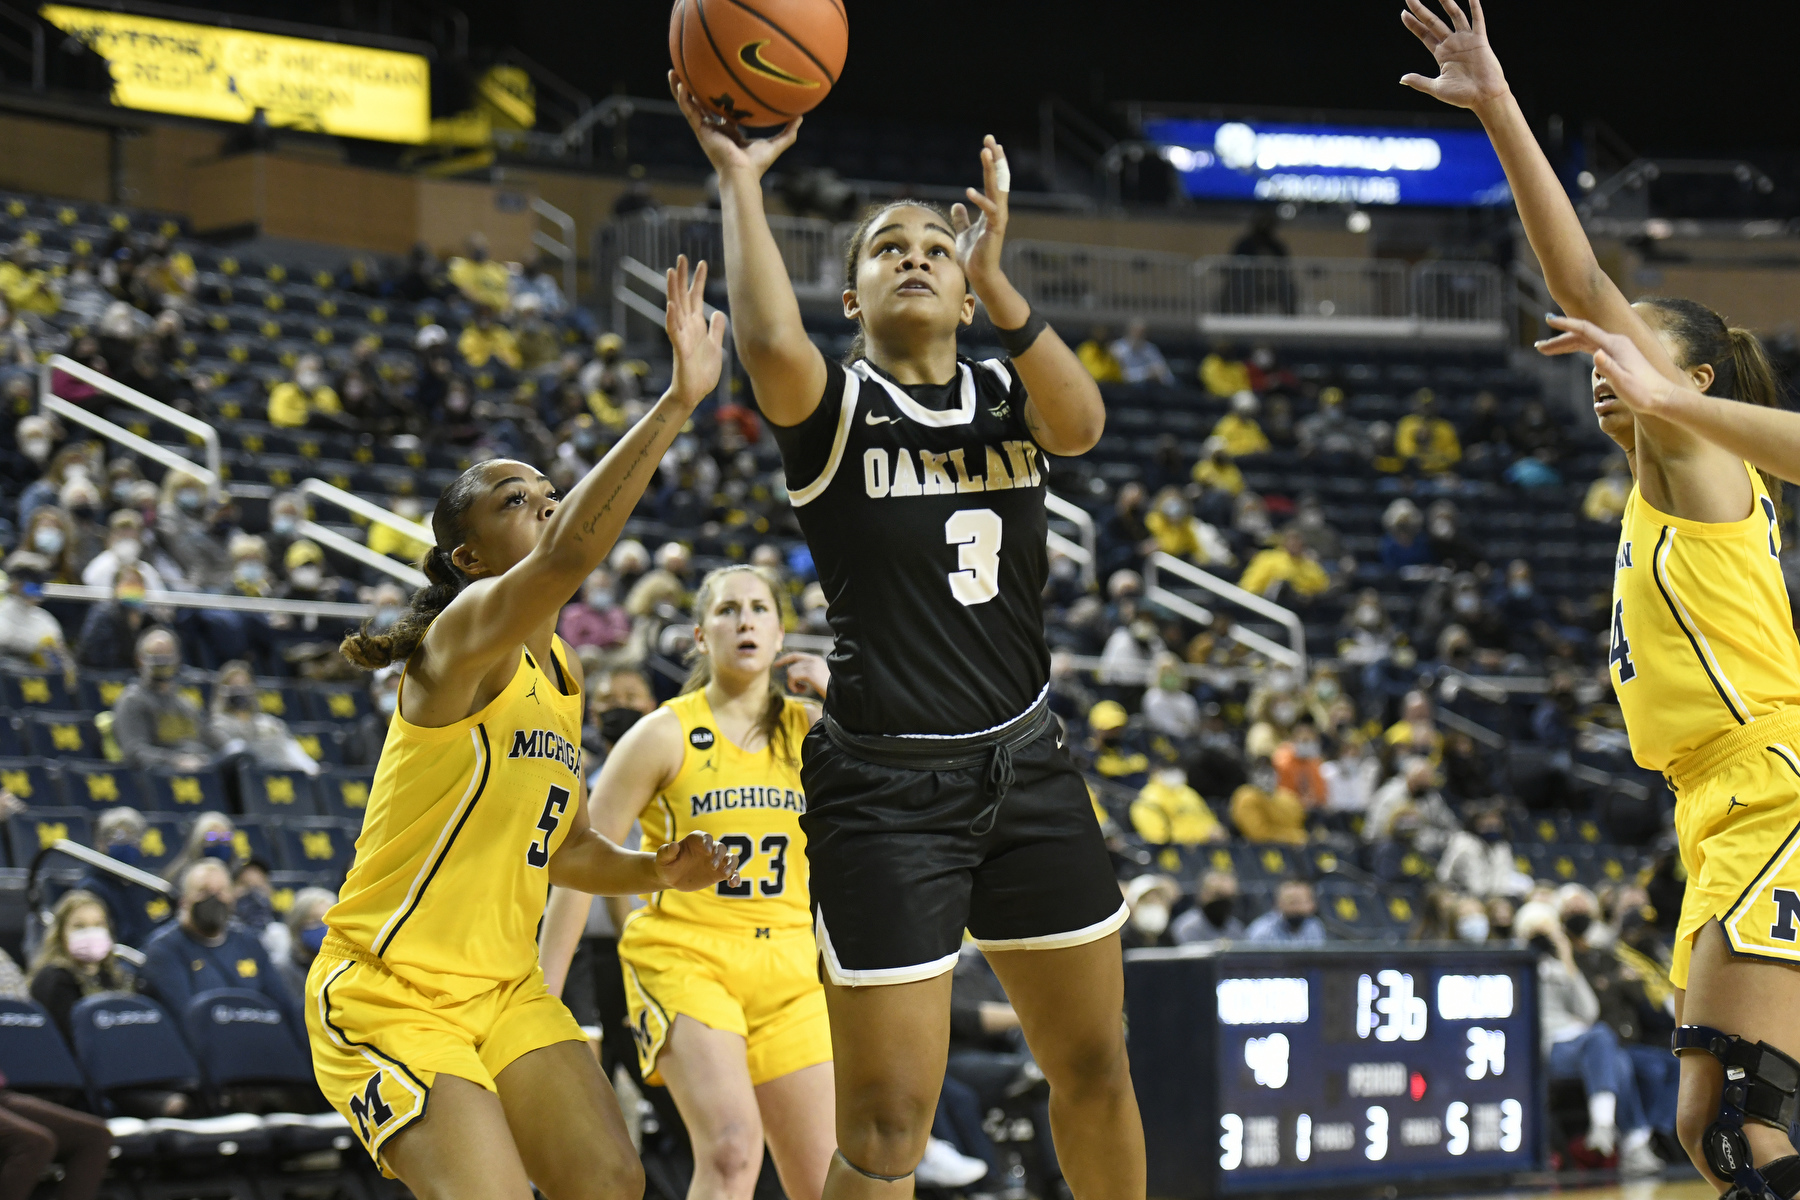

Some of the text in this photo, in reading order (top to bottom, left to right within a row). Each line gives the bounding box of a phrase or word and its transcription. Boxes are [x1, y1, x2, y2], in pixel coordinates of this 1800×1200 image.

[945, 508, 1002, 606] 3
[526, 782, 571, 869] 5
[716, 833, 790, 899] 23
[348, 1068, 396, 1148] M
[1365, 1105, 1389, 1161] 3
[1445, 1101, 1470, 1156] 5
[1500, 1098, 1523, 1153] 3
[1219, 1113, 1243, 1170] 3
